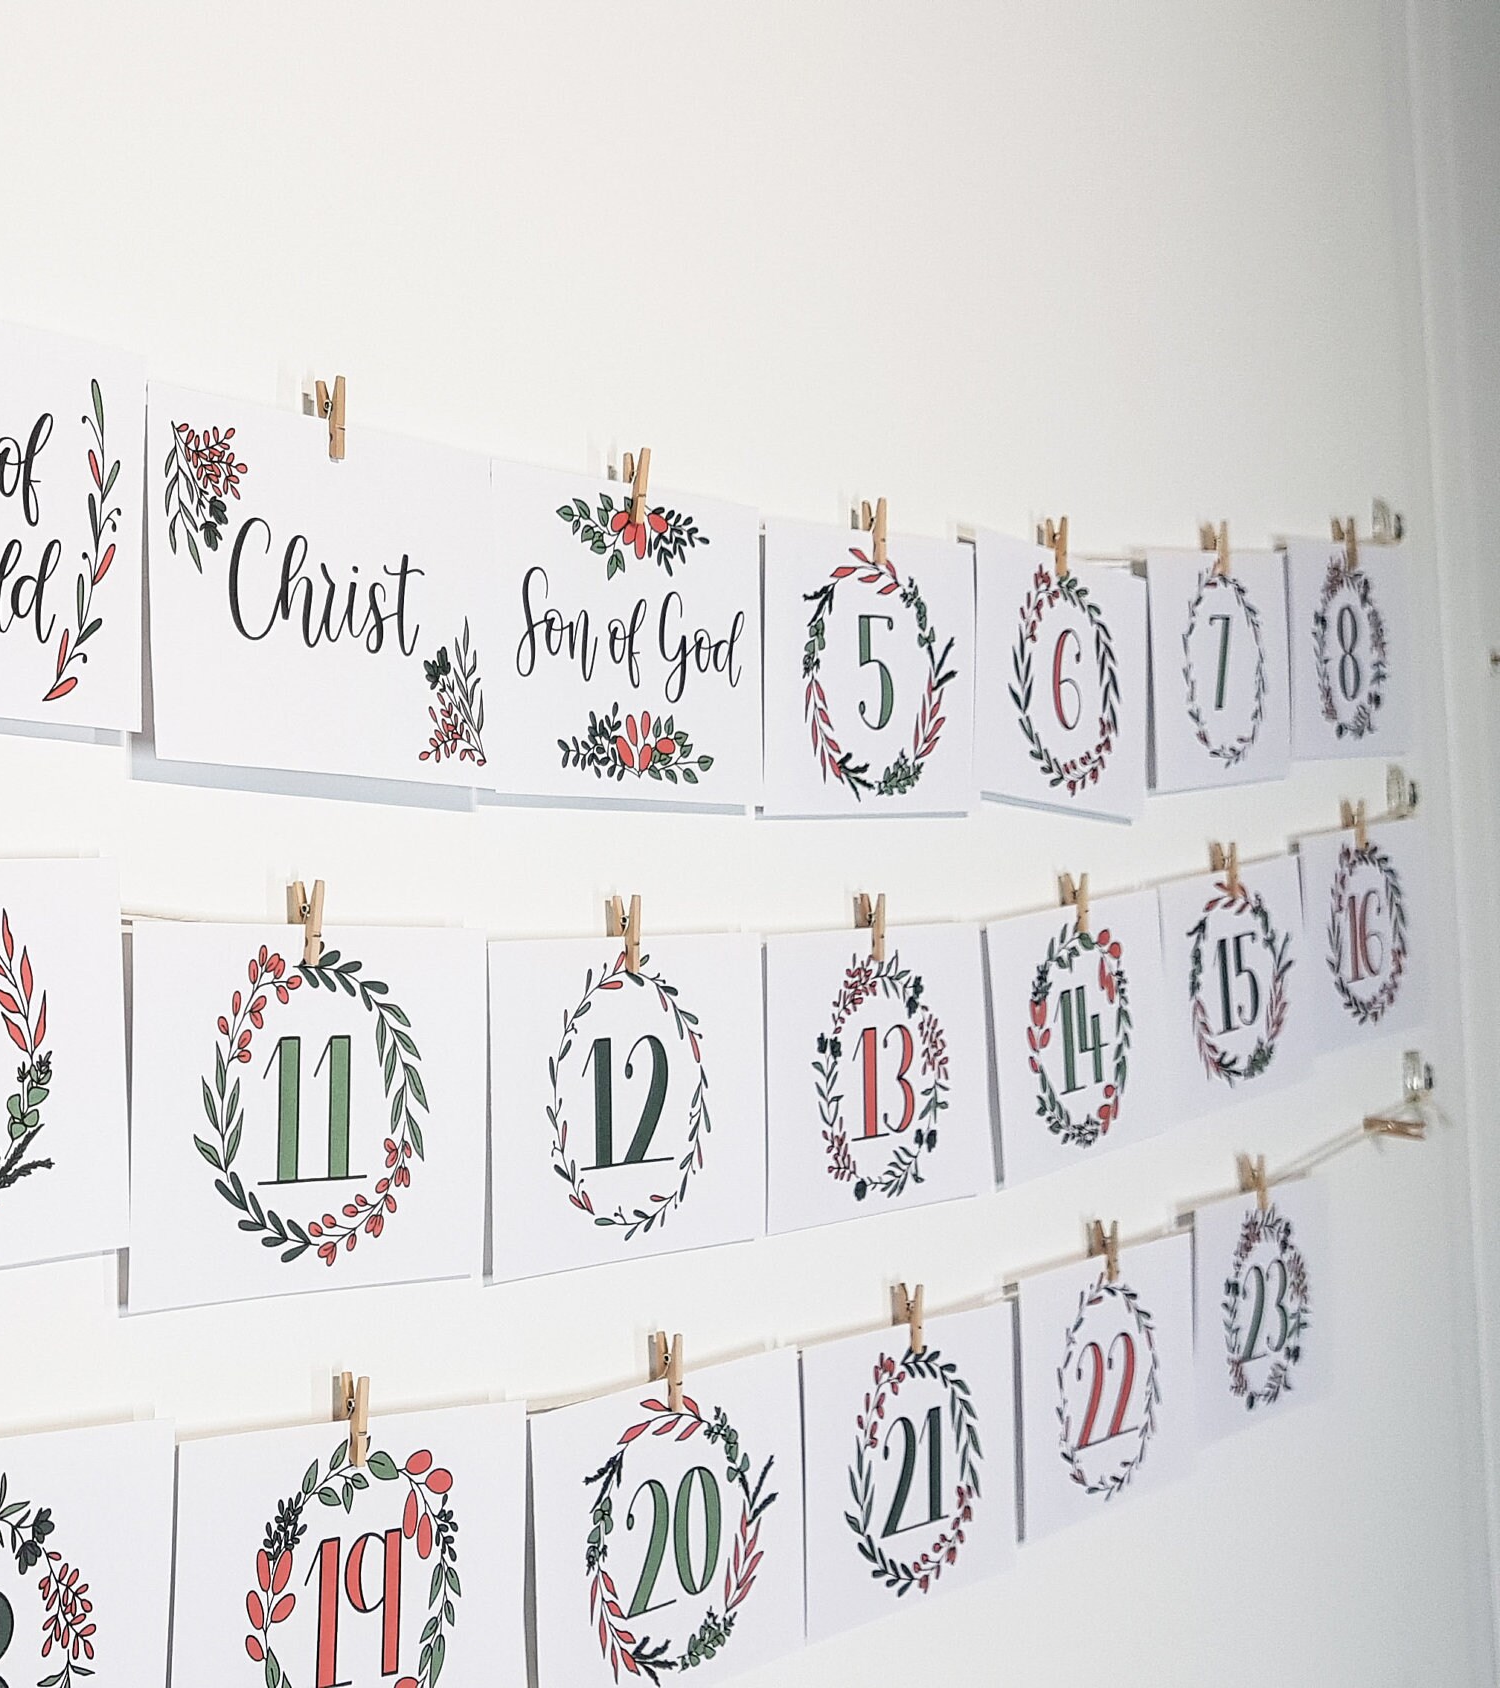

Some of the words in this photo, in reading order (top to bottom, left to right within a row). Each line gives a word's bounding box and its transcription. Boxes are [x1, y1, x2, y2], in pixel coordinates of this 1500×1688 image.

[228, 517, 424, 656] Christ
[514, 566, 599, 682] Son
[608, 596, 648, 689] of
[657, 591, 745, 703] God
[857, 613, 894, 730] 5
[1052, 629, 1082, 730] 6
[1208, 613, 1235, 711] 7
[1336, 603, 1361, 702] 8
[1213, 930, 1260, 1036] 15
[1343, 887, 1383, 985] 16
[852, 1023, 915, 1143] 13
[1056, 983, 1109, 1095] 14
[257, 1034, 367, 1186] 11
[579, 1034, 675, 1171] 12
[1239, 1259, 1290, 1366] 23
[1072, 1331, 1139, 1451] 22
[881, 1406, 949, 1538] 21
[625, 1465, 722, 1619] 20
[304, 1528, 404, 1688] 19
